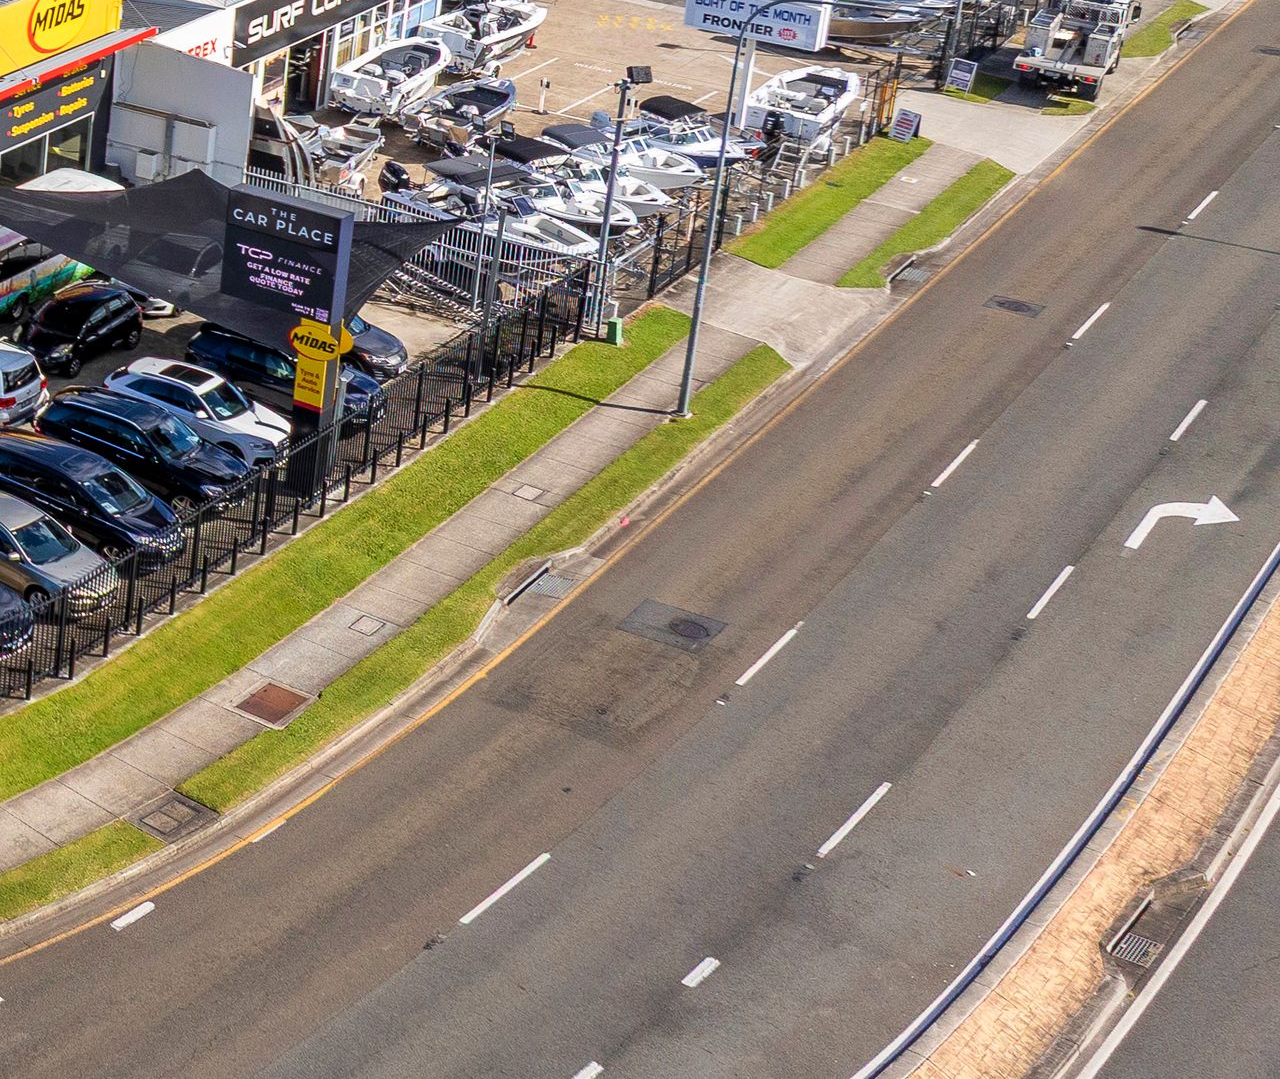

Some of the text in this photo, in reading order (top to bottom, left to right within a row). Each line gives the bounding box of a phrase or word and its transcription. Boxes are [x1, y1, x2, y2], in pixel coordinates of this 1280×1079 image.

[730, 0, 745, 12] OF
[773, 8, 811, 26] MONTH
[702, 14, 773, 37] FRONTIER
[13, 102, 34, 118] Tyres
[60, 97, 87, 116] Repairs
[11, 112, 54, 136] Suspension
[271, 208, 296, 221] THE
[233, 208, 333, 245] CAR PLACE
[236, 243, 322, 275] TCP FINANCE
[247, 262, 311, 285] GET A LOW RATE
[249, 276, 275, 288] QUOTE
[277, 284, 303, 296] TODAY
[292, 332, 337, 354] MIDAS
[297, 382, 320, 394] Service
[301, 377, 318, 386] Auto
